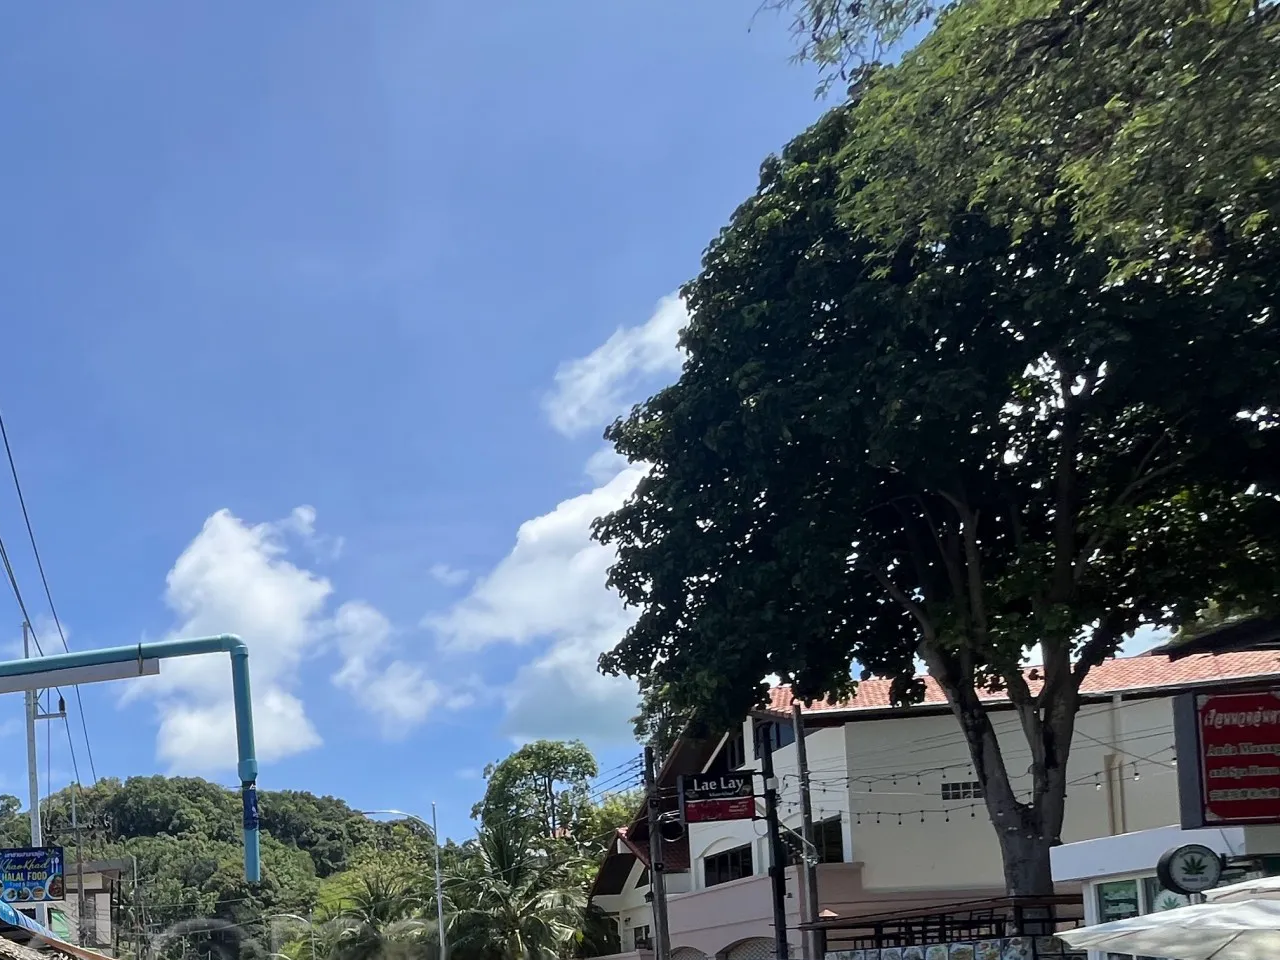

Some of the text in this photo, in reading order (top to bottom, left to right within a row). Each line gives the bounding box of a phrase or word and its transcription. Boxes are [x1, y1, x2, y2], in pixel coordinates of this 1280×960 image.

[693, 777, 744, 793] Lae Lay
[2, 871, 47, 881] HALAL FOOD
